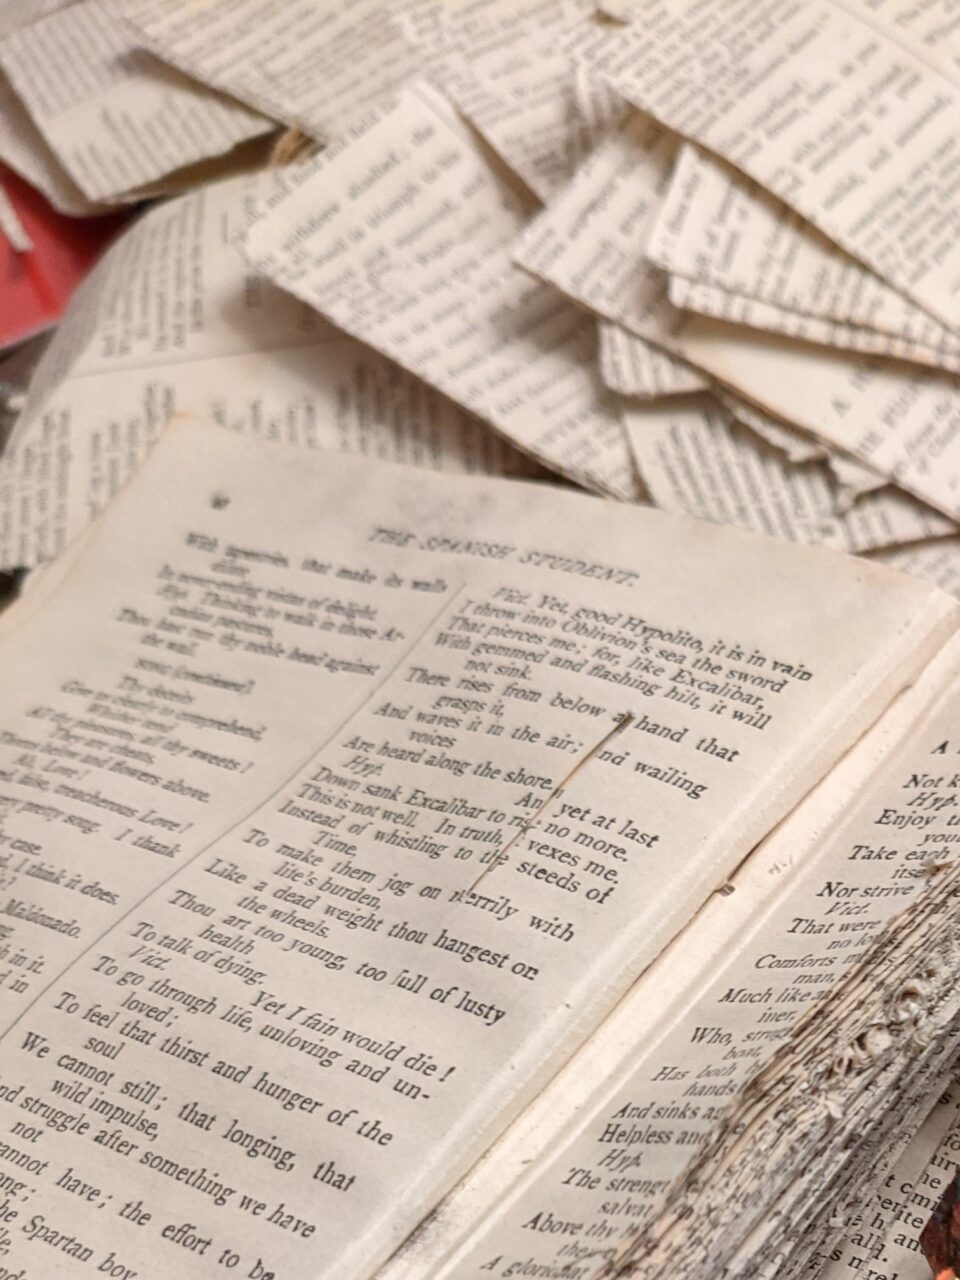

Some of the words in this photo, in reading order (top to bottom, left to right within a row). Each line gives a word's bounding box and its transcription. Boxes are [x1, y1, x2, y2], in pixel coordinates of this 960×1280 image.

[628, 654, 665, 678] like
[671, 668, 765, 710] Excalibar,
[692, 652, 721, 675] the
[726, 664, 788, 694] sword
[550, 692, 607, 718] below
[590, 661, 661, 697] flashing
[733, 704, 771, 731] will
[634, 715, 685, 743] hand
[696, 737, 740, 764] that
[633, 757, 709, 800] wailing
[621, 819, 660, 849] last
[874, 810, 935, 830] Enjoy
[526, 837, 582, 867] vexes
[588, 859, 620, 885] me.
[572, 830, 628, 862] more.
[848, 846, 897, 861] Take
[517, 859, 579, 893] steeds
[288, 936, 348, 971] young,
[325, 902, 383, 934] weight
[388, 921, 427, 946] thou
[433, 930, 508, 968] hangest
[457, 990, 506, 1027] lusty
[719, 988, 772, 1004] Much
[148, 976, 217, 1015] through
[220, 1005, 254, 1033] life,
[260, 1024, 343, 1067] unloving
[346, 1055, 388, 1084] and
[251, 991, 282, 1014] Yet
[304, 1010, 339, 1038] fain
[341, 1026, 400, 1062] would
[160, 1036, 209, 1067] thirst
[211, 1060, 250, 1085] and
[252, 1072, 323, 1113] hunger
[356, 1118, 394, 1147] the
[57, 1052, 116, 1087] cannot
[178, 1100, 218, 1131] that
[223, 1120, 297, 1173] longing,
[312, 1161, 357, 1192] that
[598, 1124, 673, 1147] Helpless
[19, 1091, 91, 1138] struggle
[93, 1127, 139, 1158] after
[140, 1148, 238, 1206] something
[266, 1203, 316, 1239] have
[21, 1213, 95, 1263] Spartan
[119, 1199, 152, 1228] the
[161, 1222, 213, 1256] effort
